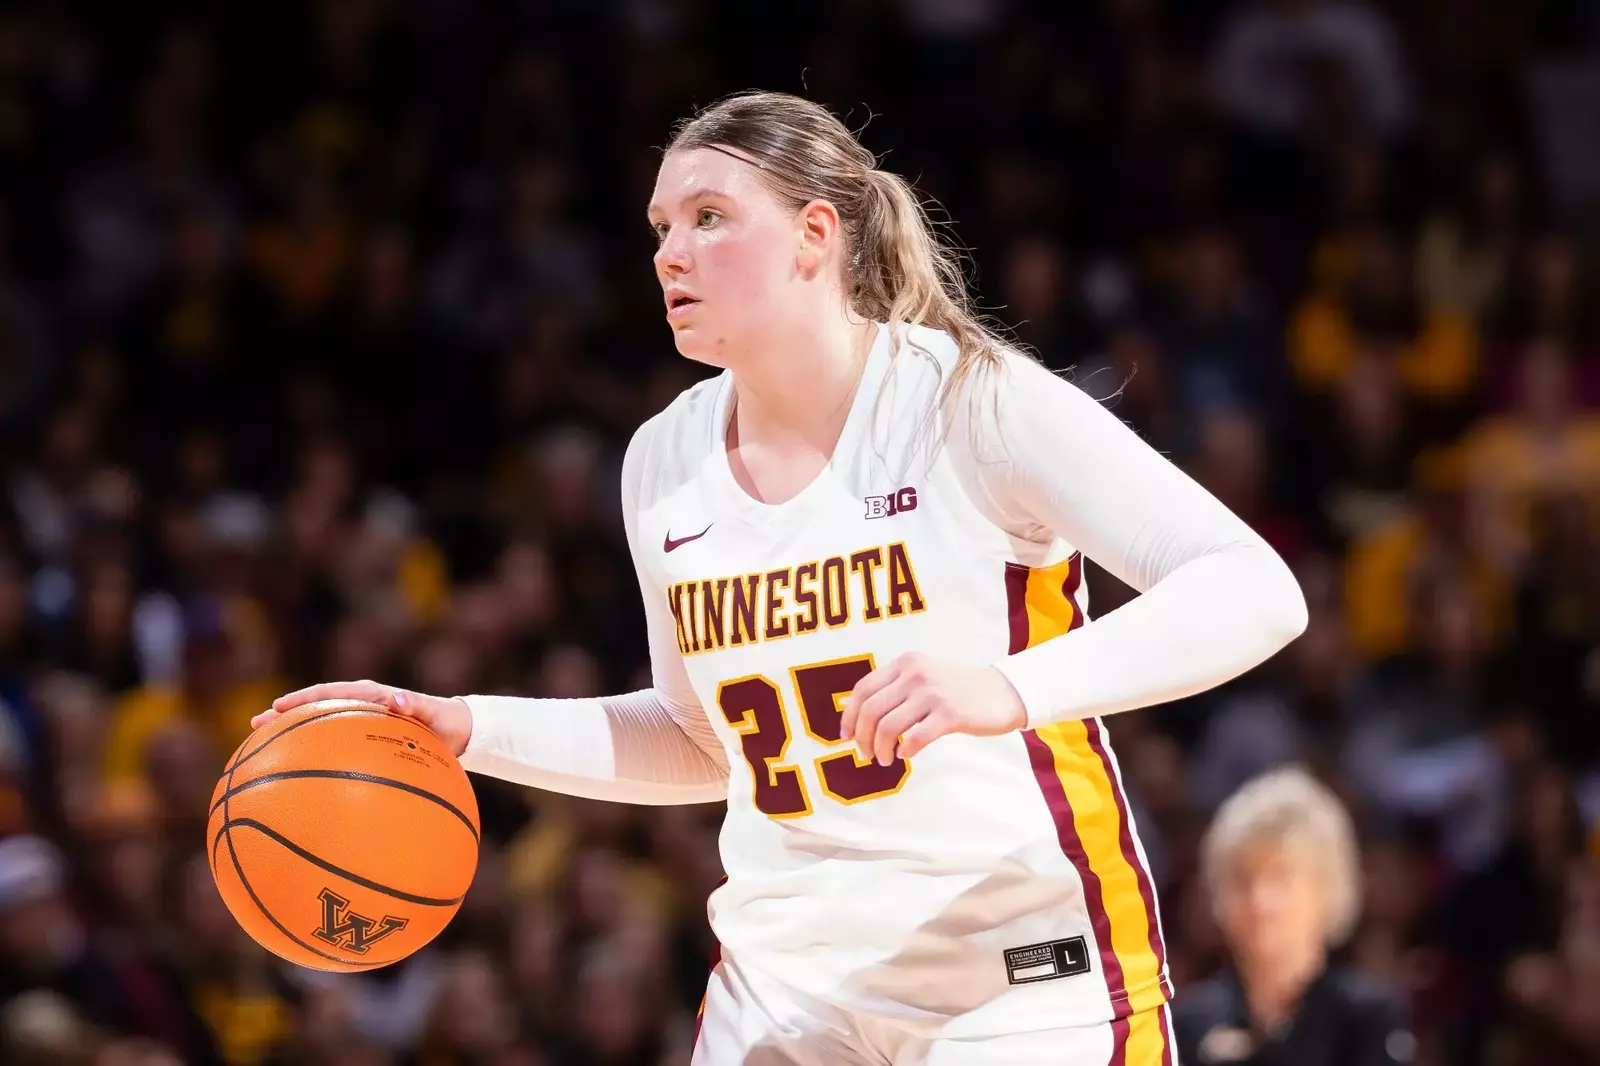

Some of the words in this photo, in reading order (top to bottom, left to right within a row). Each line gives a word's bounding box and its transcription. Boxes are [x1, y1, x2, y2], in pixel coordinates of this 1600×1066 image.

[667, 541, 927, 656] MINNESOTA
[716, 653, 912, 820] 25
[1009, 947, 1051, 960] ENGINEERED
[1064, 950, 1077, 965] L
